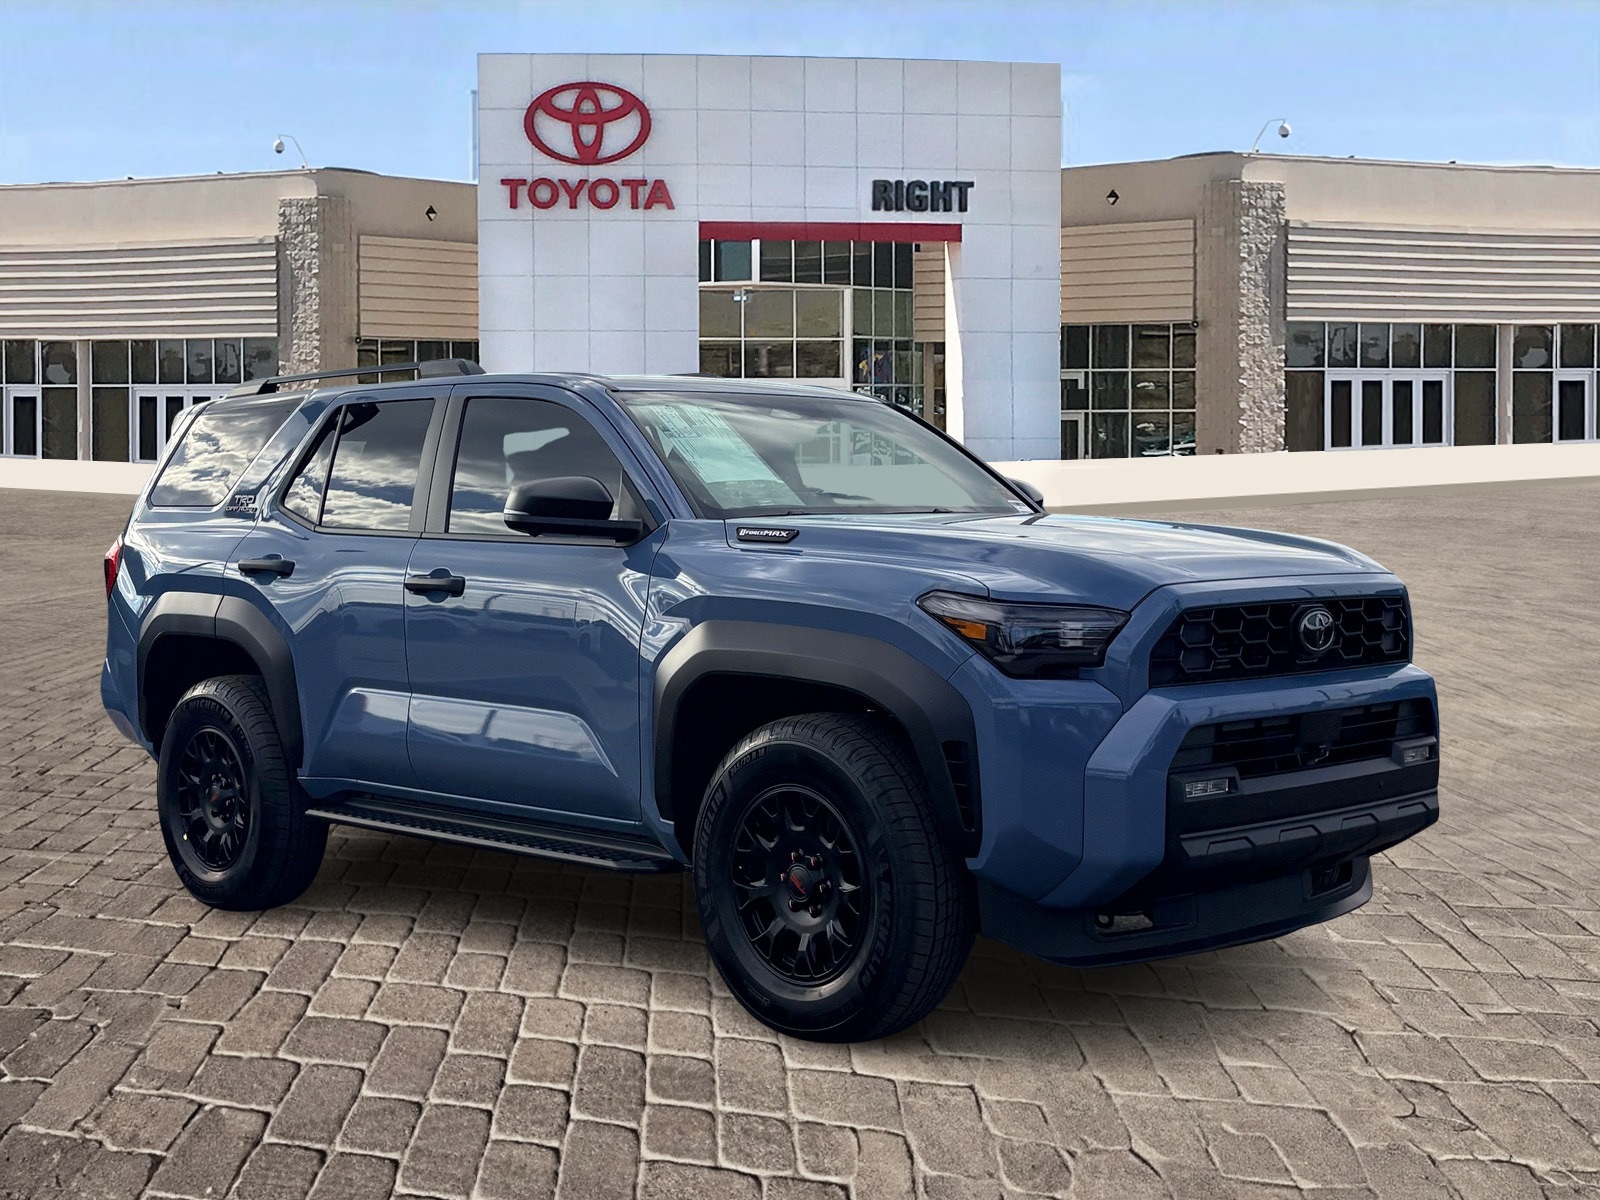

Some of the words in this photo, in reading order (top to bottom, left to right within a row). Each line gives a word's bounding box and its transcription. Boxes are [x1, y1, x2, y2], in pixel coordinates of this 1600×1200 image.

[500, 179, 675, 210] TOYOTA
[871, 179, 975, 213] RIGHT
[234, 495, 255, 507] TRD
